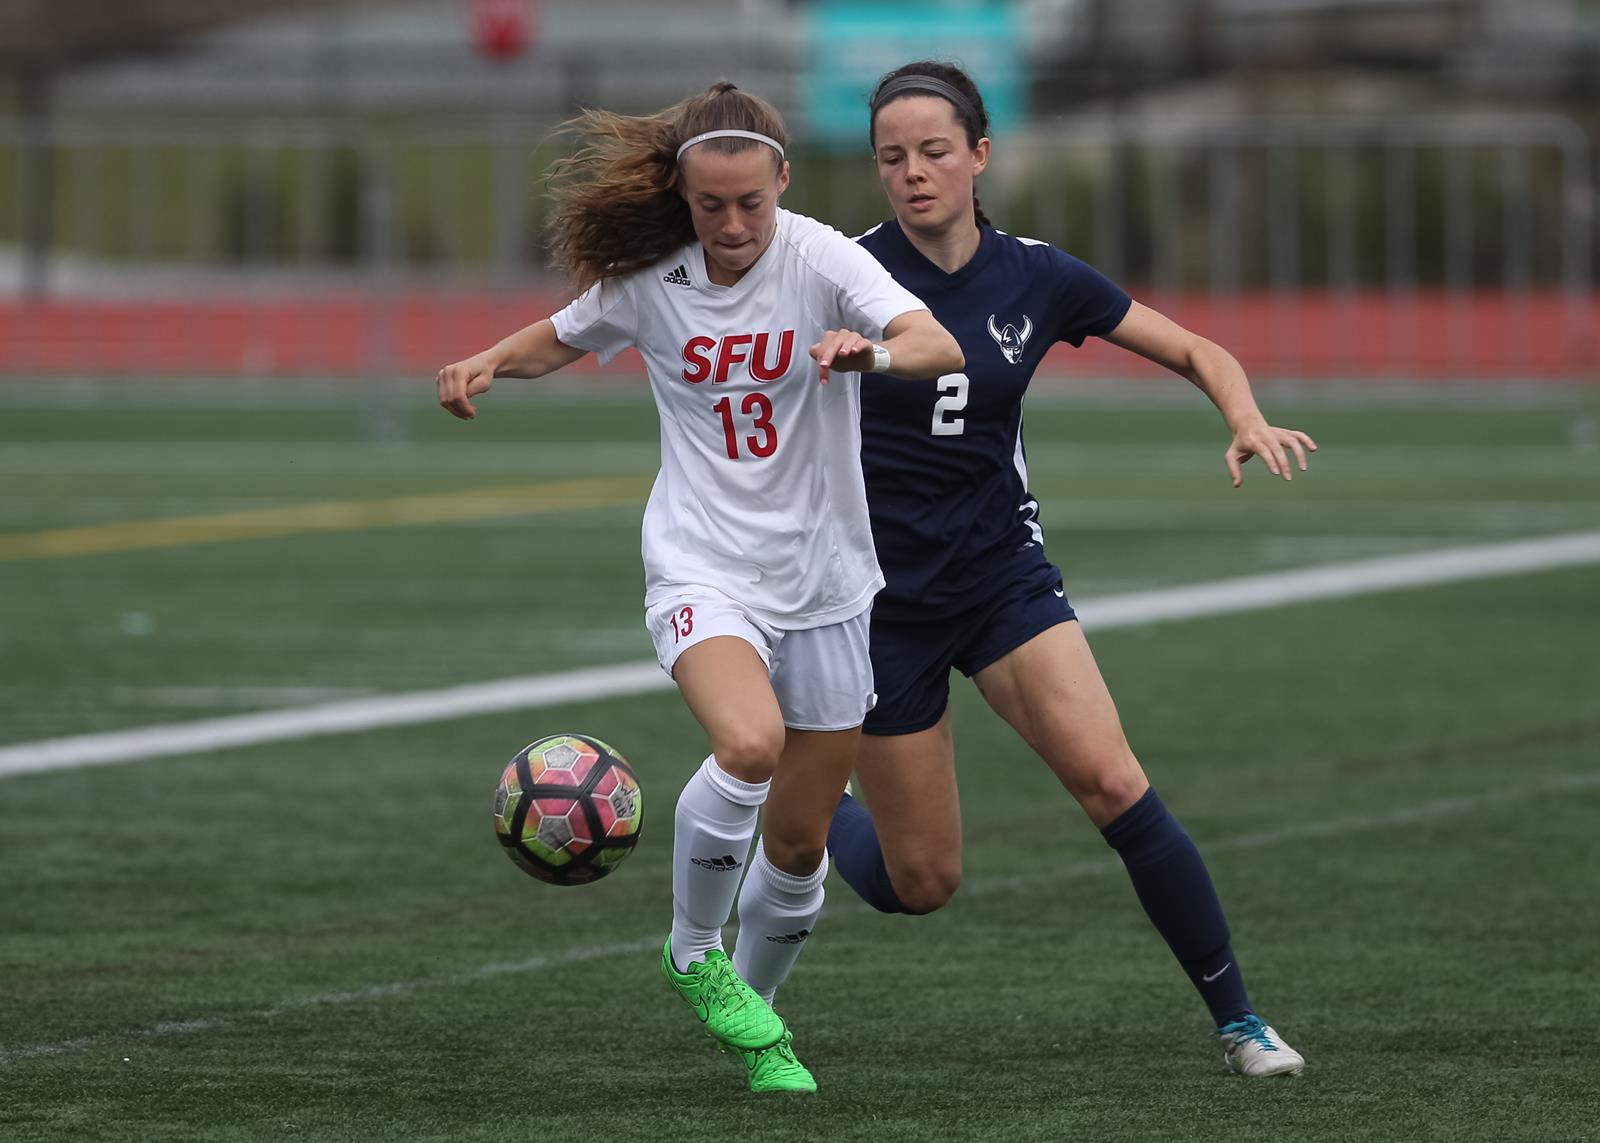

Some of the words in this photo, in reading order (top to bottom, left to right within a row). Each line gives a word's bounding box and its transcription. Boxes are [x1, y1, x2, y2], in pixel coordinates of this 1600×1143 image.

[663, 275, 691, 286] adidas
[681, 330, 795, 385] SFU
[712, 392, 778, 460] 13
[931, 373, 970, 436] 2
[670, 606, 694, 644] 13
